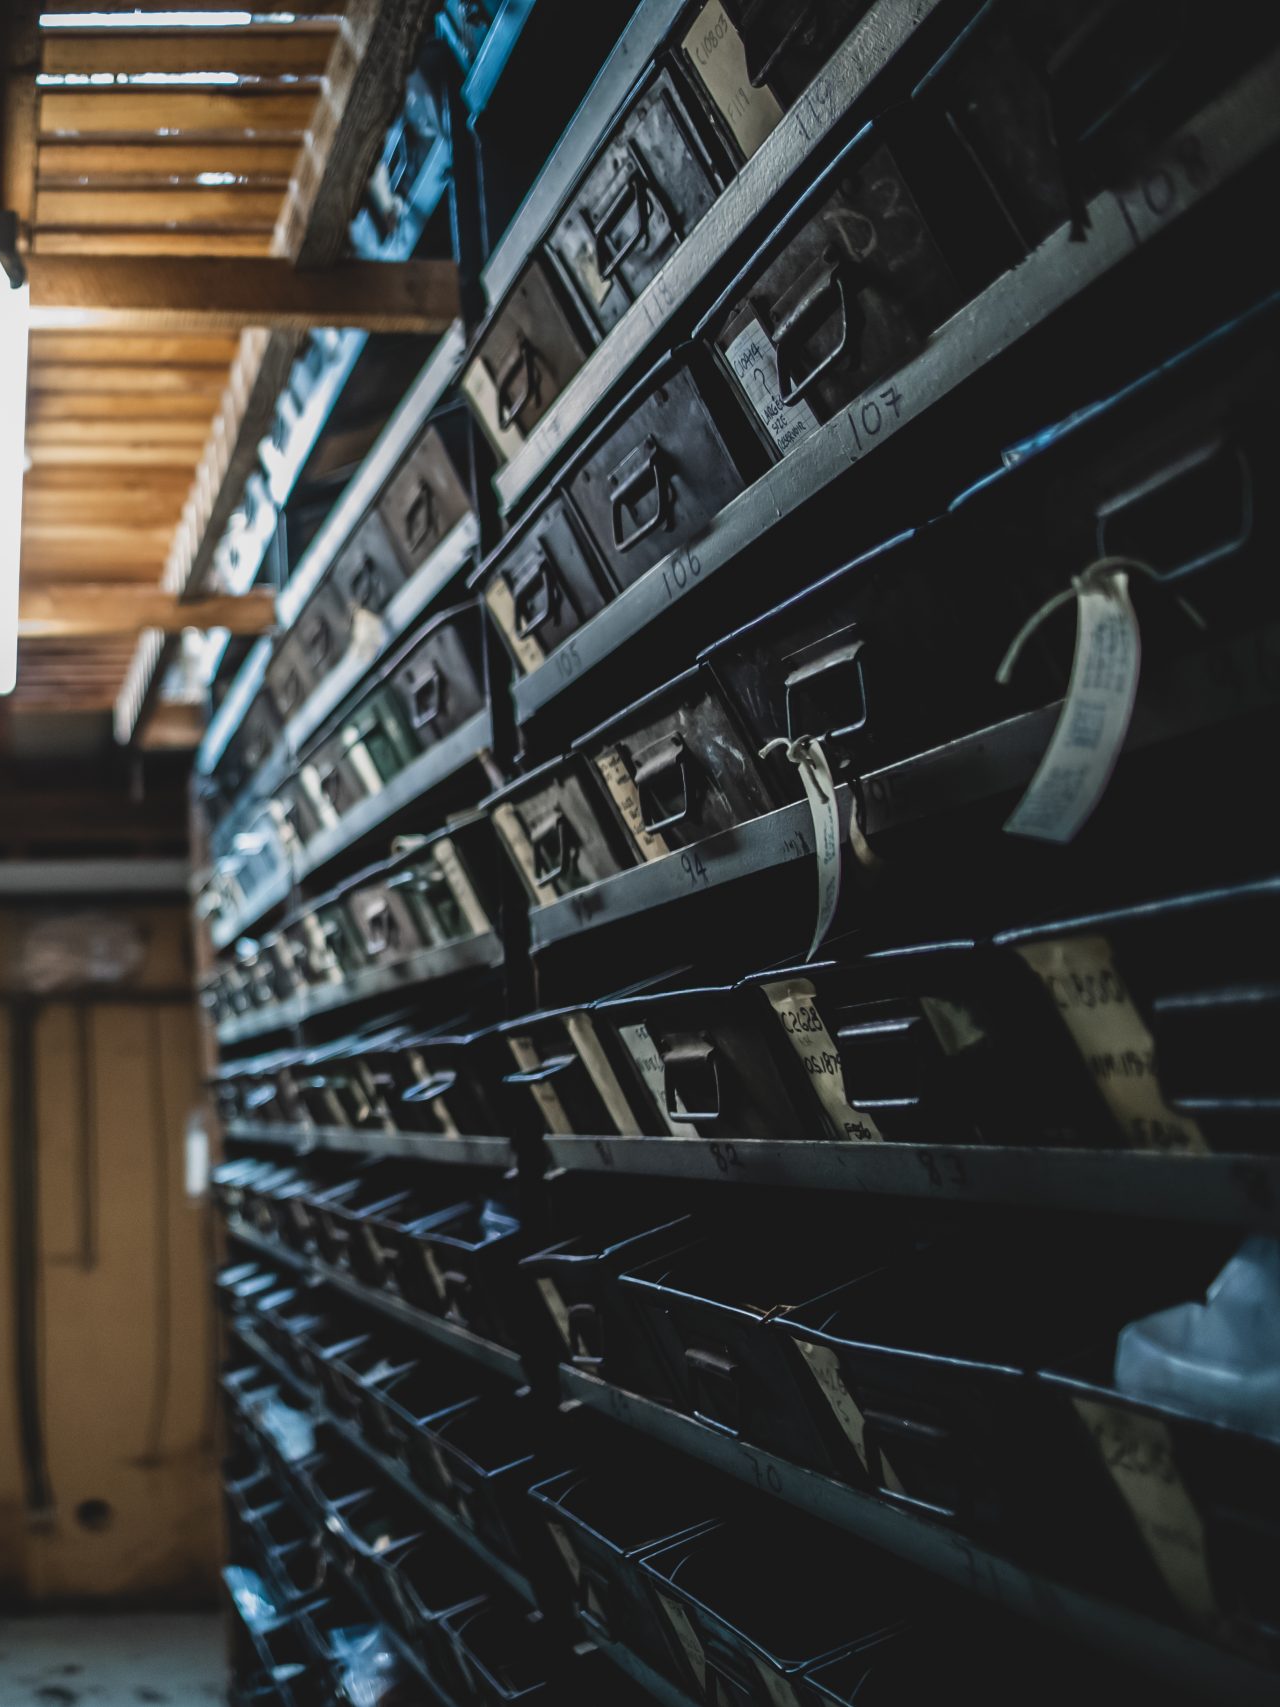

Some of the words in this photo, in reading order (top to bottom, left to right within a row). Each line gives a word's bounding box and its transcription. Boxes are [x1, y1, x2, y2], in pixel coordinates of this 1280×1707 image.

[847, 387, 902, 451] 107
[662, 550, 701, 600] 106
[680, 853, 708, 888] 94
[744, 1450, 783, 1494] 70
